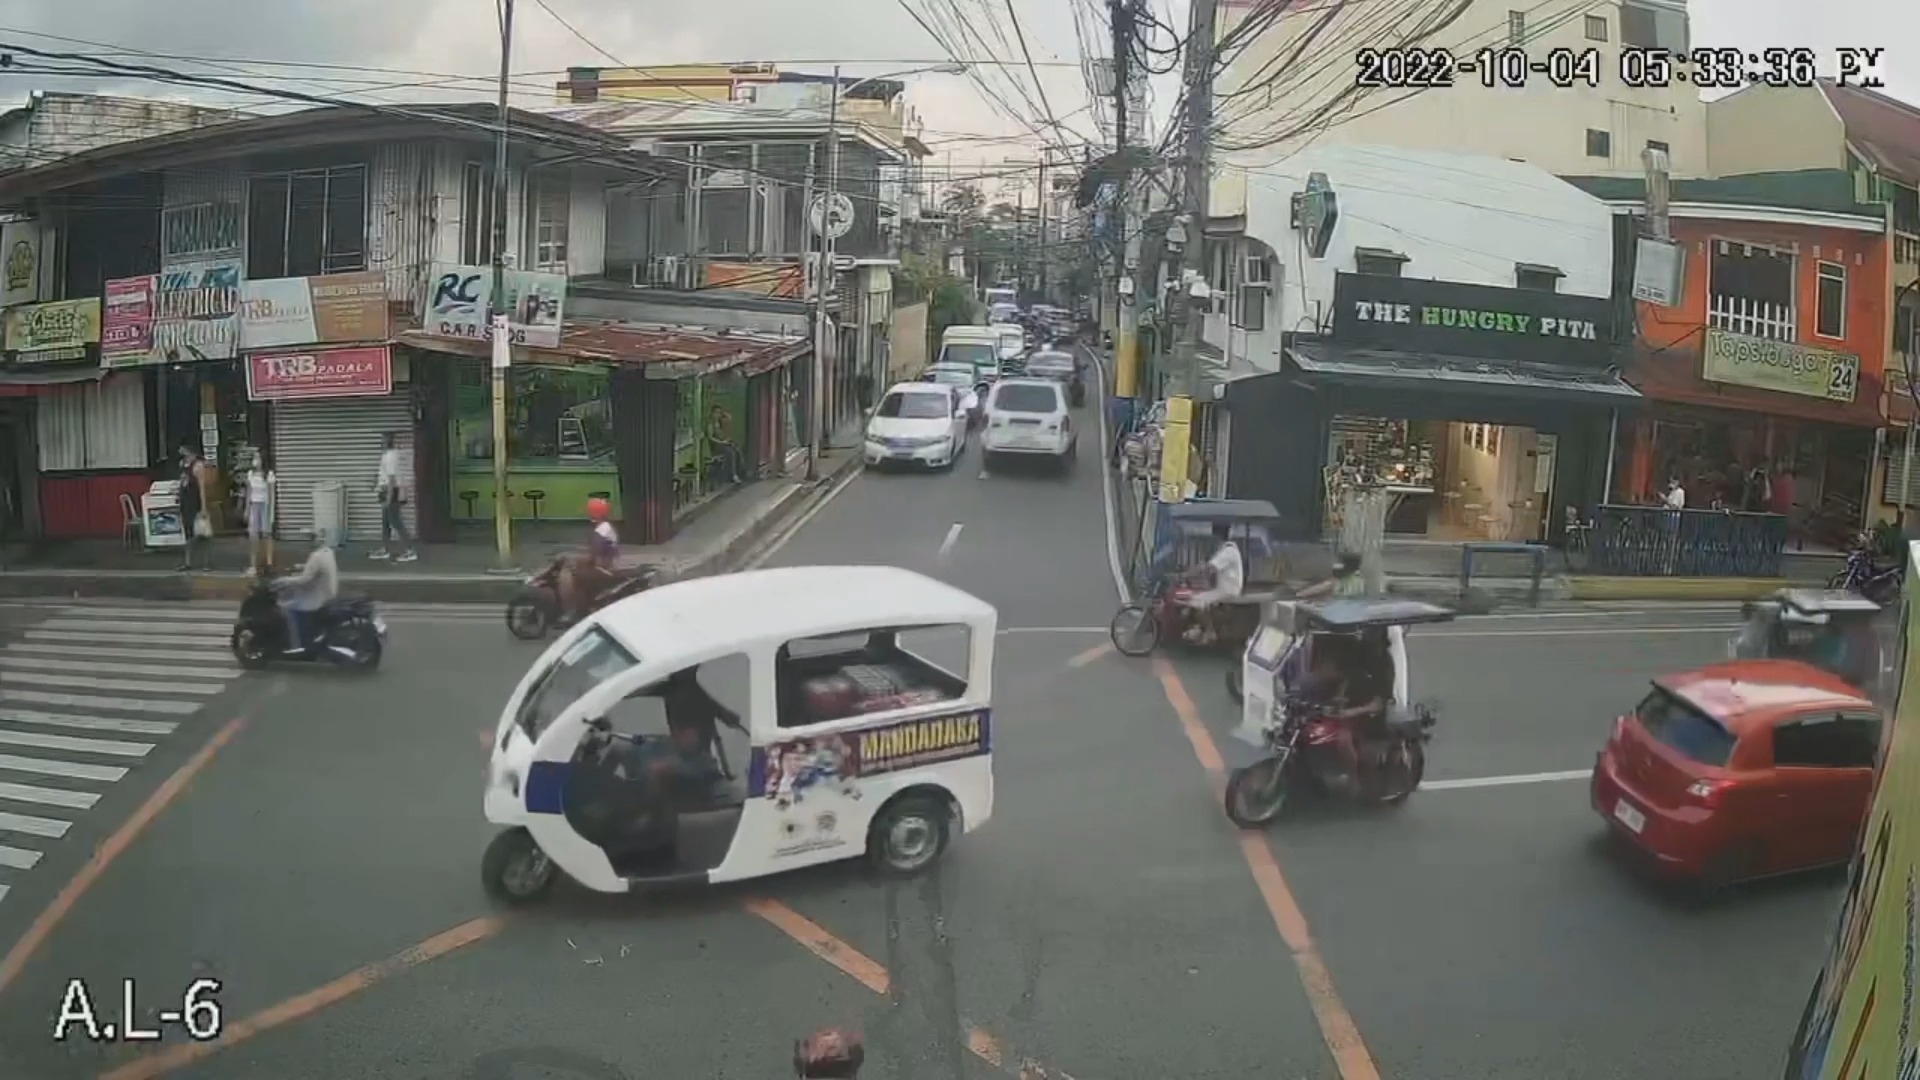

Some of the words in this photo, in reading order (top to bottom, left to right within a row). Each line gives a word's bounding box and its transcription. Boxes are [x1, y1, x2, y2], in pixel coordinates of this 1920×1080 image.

[433, 273, 482, 308] RC
[1355, 301, 1411, 324] THE
[1421, 306, 1530, 333] HUNGRY
[1540, 317, 1597, 340] PITA
[261, 355, 317, 380] TRB
[317, 362, 373, 375] PADALA
[1831, 366, 1852, 390] 24
